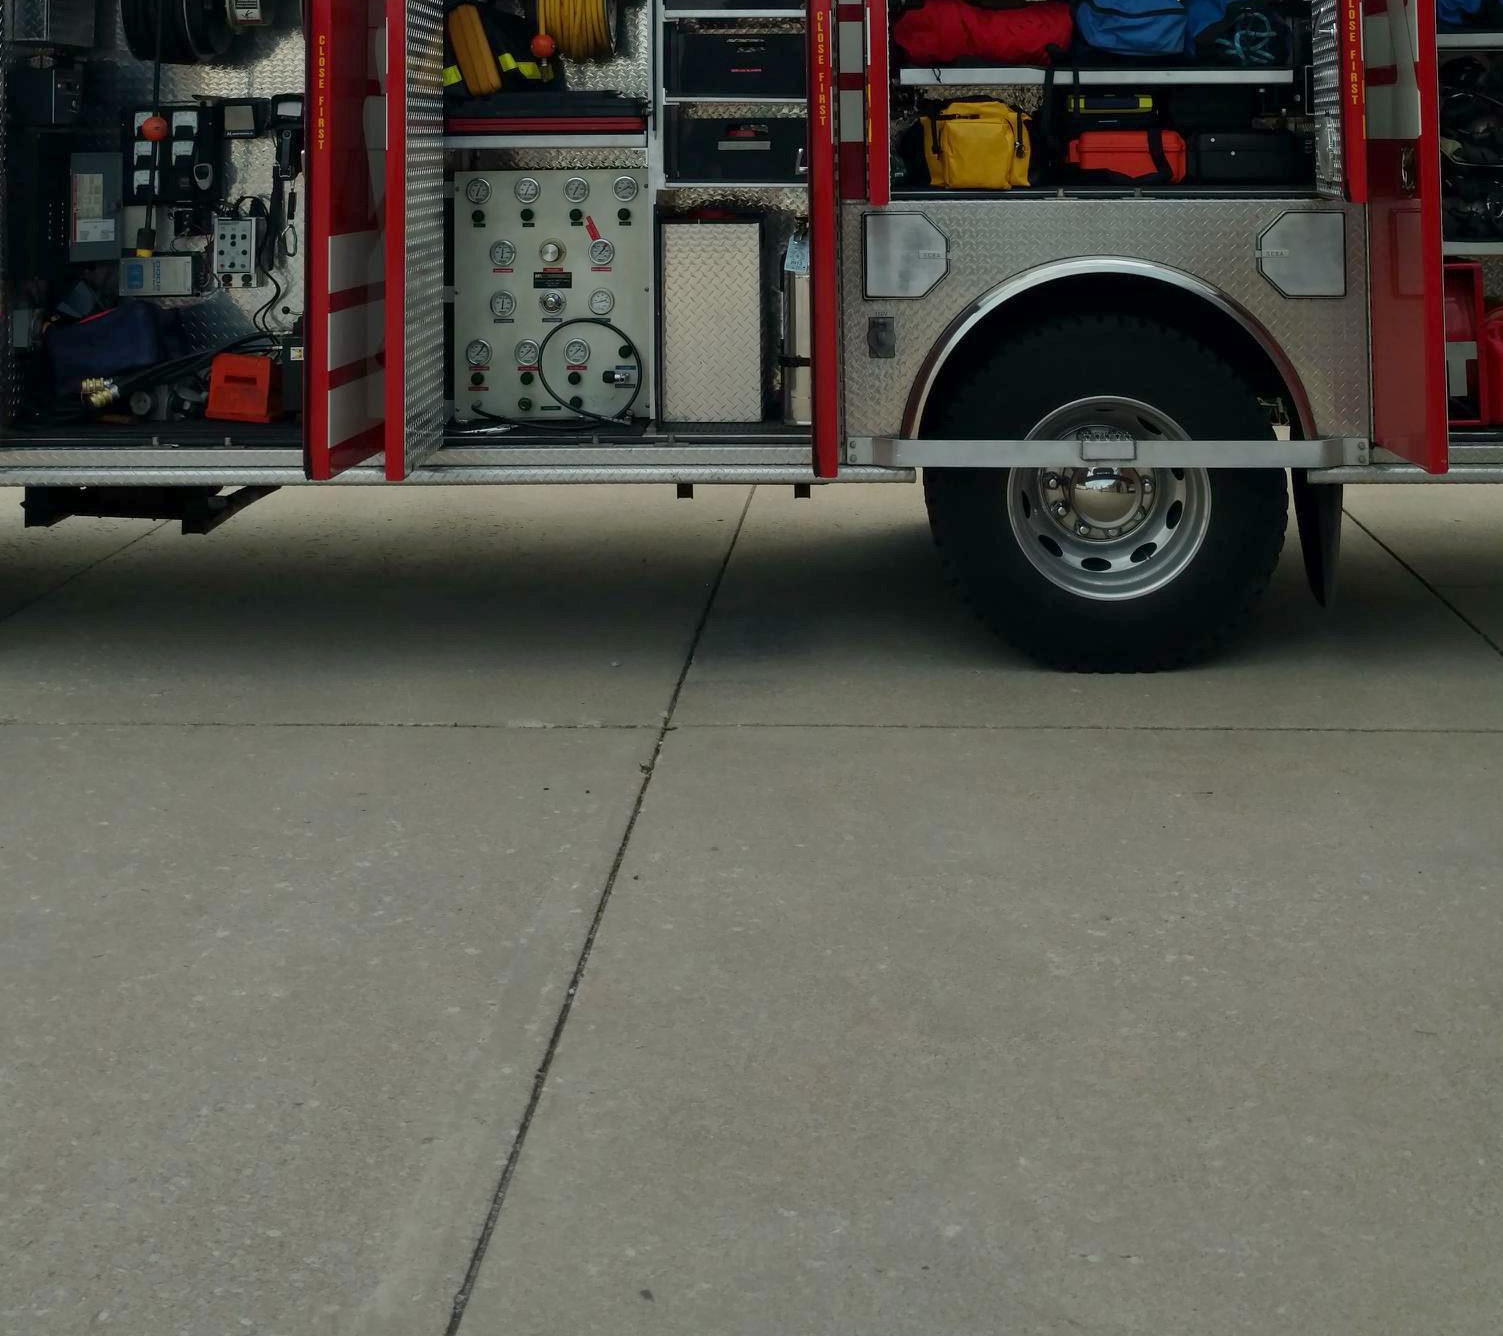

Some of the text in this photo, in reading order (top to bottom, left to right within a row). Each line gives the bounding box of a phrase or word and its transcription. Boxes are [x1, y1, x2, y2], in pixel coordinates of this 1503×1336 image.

[317, 35, 326, 150] CLOSE FIRST
[816, 10, 827, 126] CLOSE FIRST
[1350, 49, 1360, 105] FIRST
